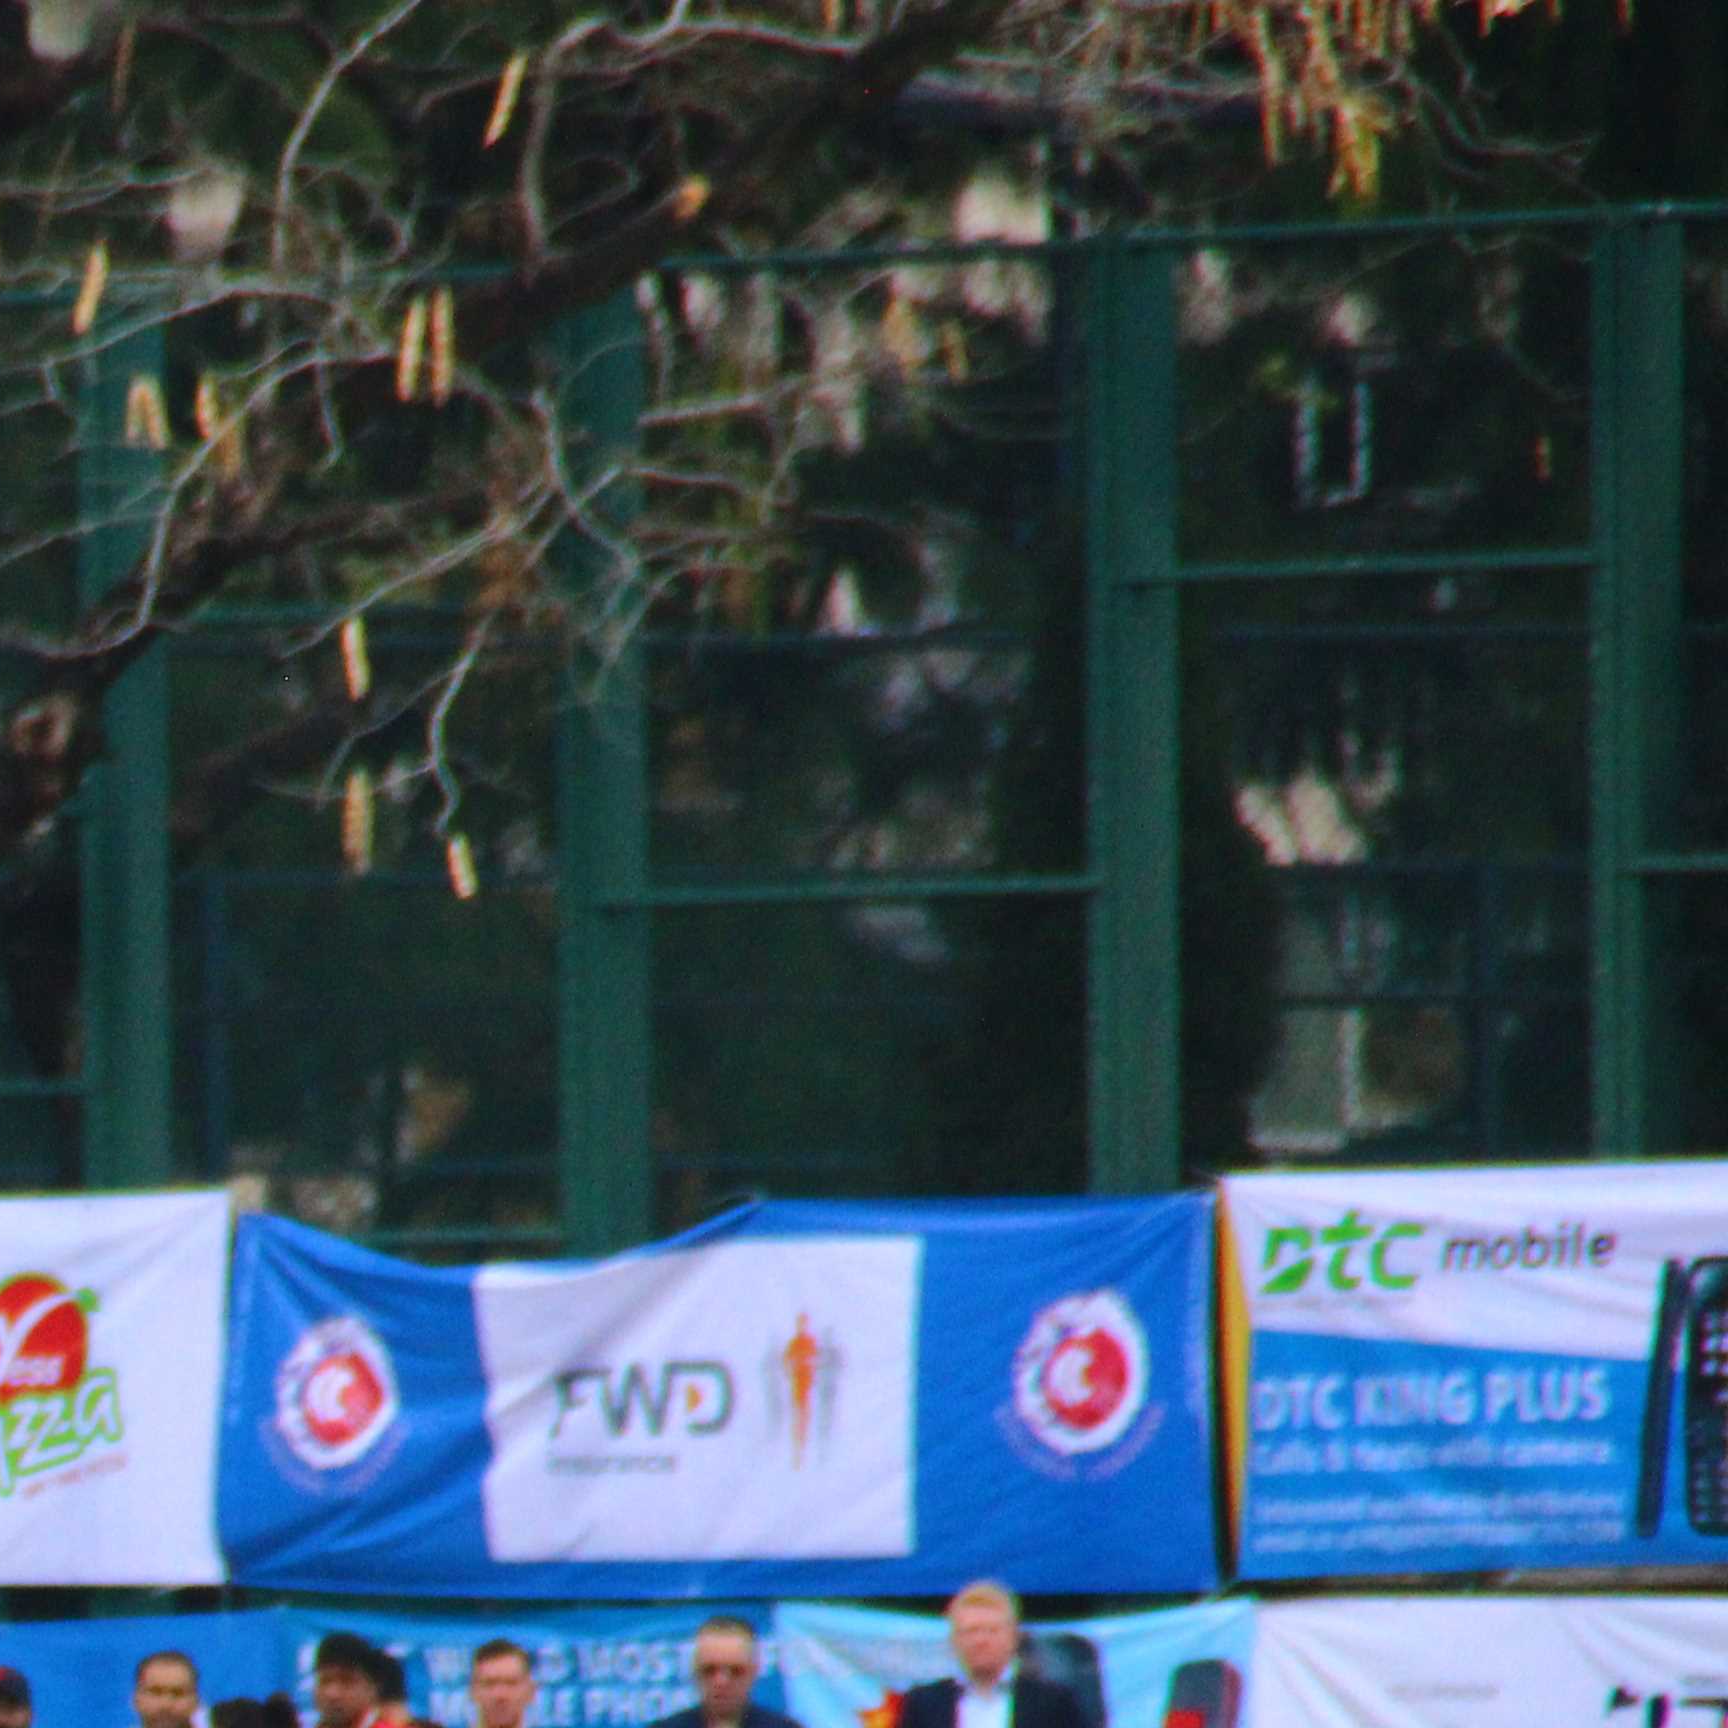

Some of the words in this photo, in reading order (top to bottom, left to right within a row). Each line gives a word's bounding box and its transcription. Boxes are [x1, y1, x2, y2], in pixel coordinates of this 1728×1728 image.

[1440, 1221, 1617, 1273] mobile
[548, 1360, 735, 1438] FWD
[1251, 1376, 1345, 1431] DTC
[1354, 1368, 1477, 1427] KING
[1484, 1365, 1611, 1423] PLUS
